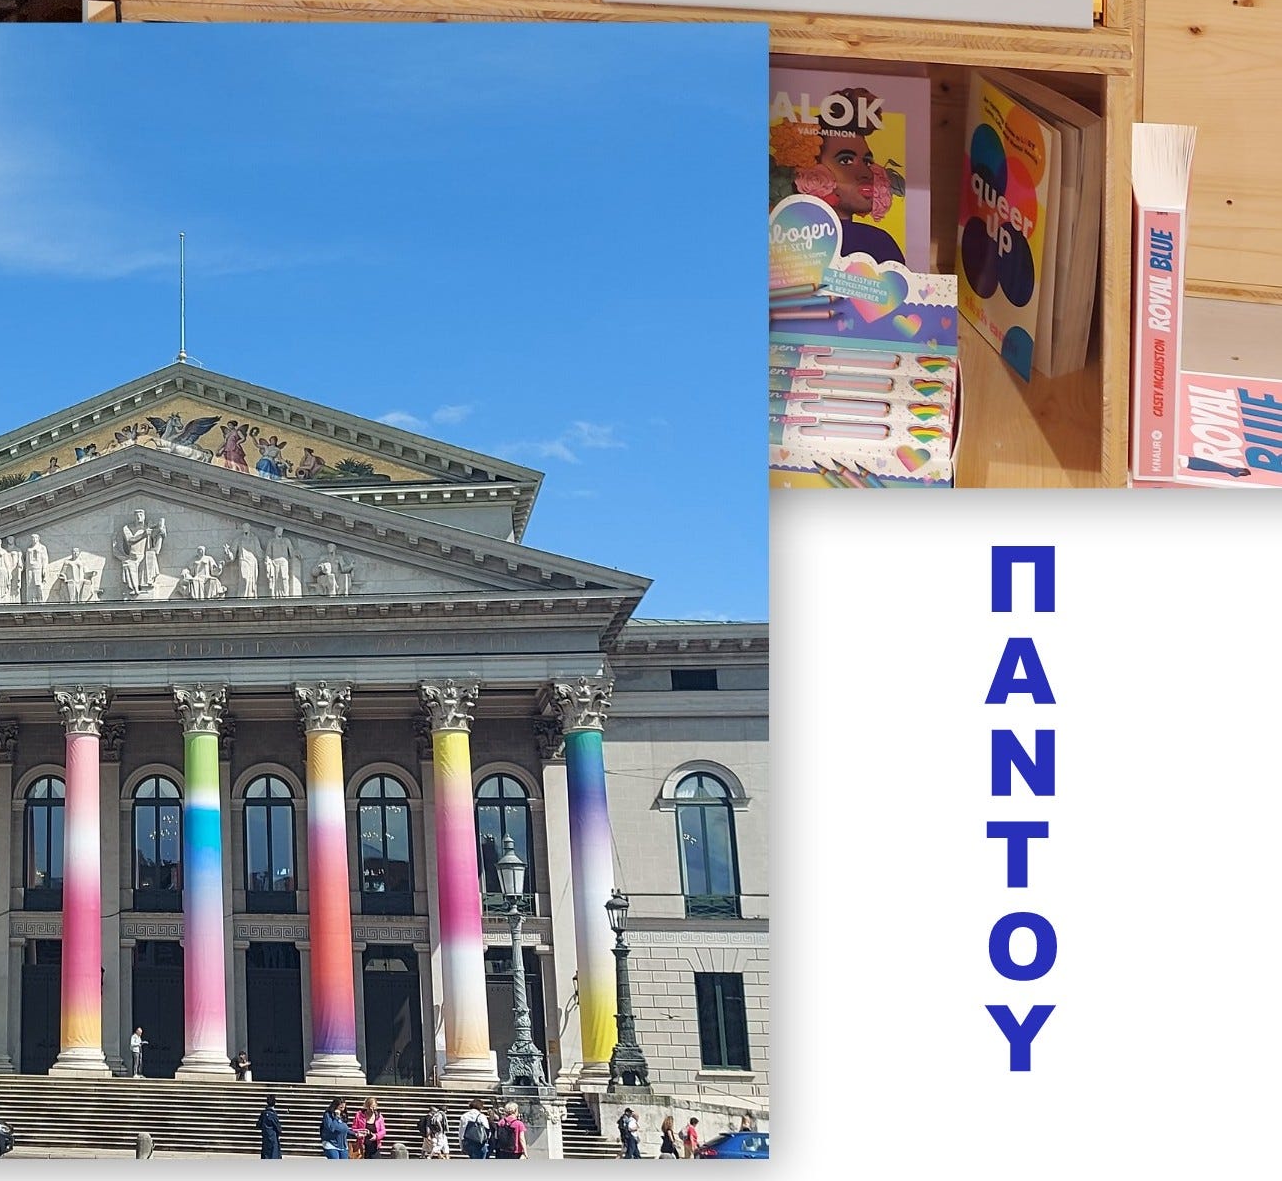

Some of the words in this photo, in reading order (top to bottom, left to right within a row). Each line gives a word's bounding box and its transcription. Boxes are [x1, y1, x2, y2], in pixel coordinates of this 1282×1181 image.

[770, 91, 885, 130] ALOK
[797, 127, 856, 138] VAID-MENON
[971, 172, 1034, 241] queer
[987, 212, 1012, 258] up
[1150, 227, 1174, 273] BLUE
[1148, 275, 1172, 333] ROYAL
[1154, 338, 1166, 387] MCQUISTON
[1153, 388, 1164, 418] CASEY
[1188, 384, 1244, 469] ROYAL
[1152, 441, 1162, 472] KNAUR
